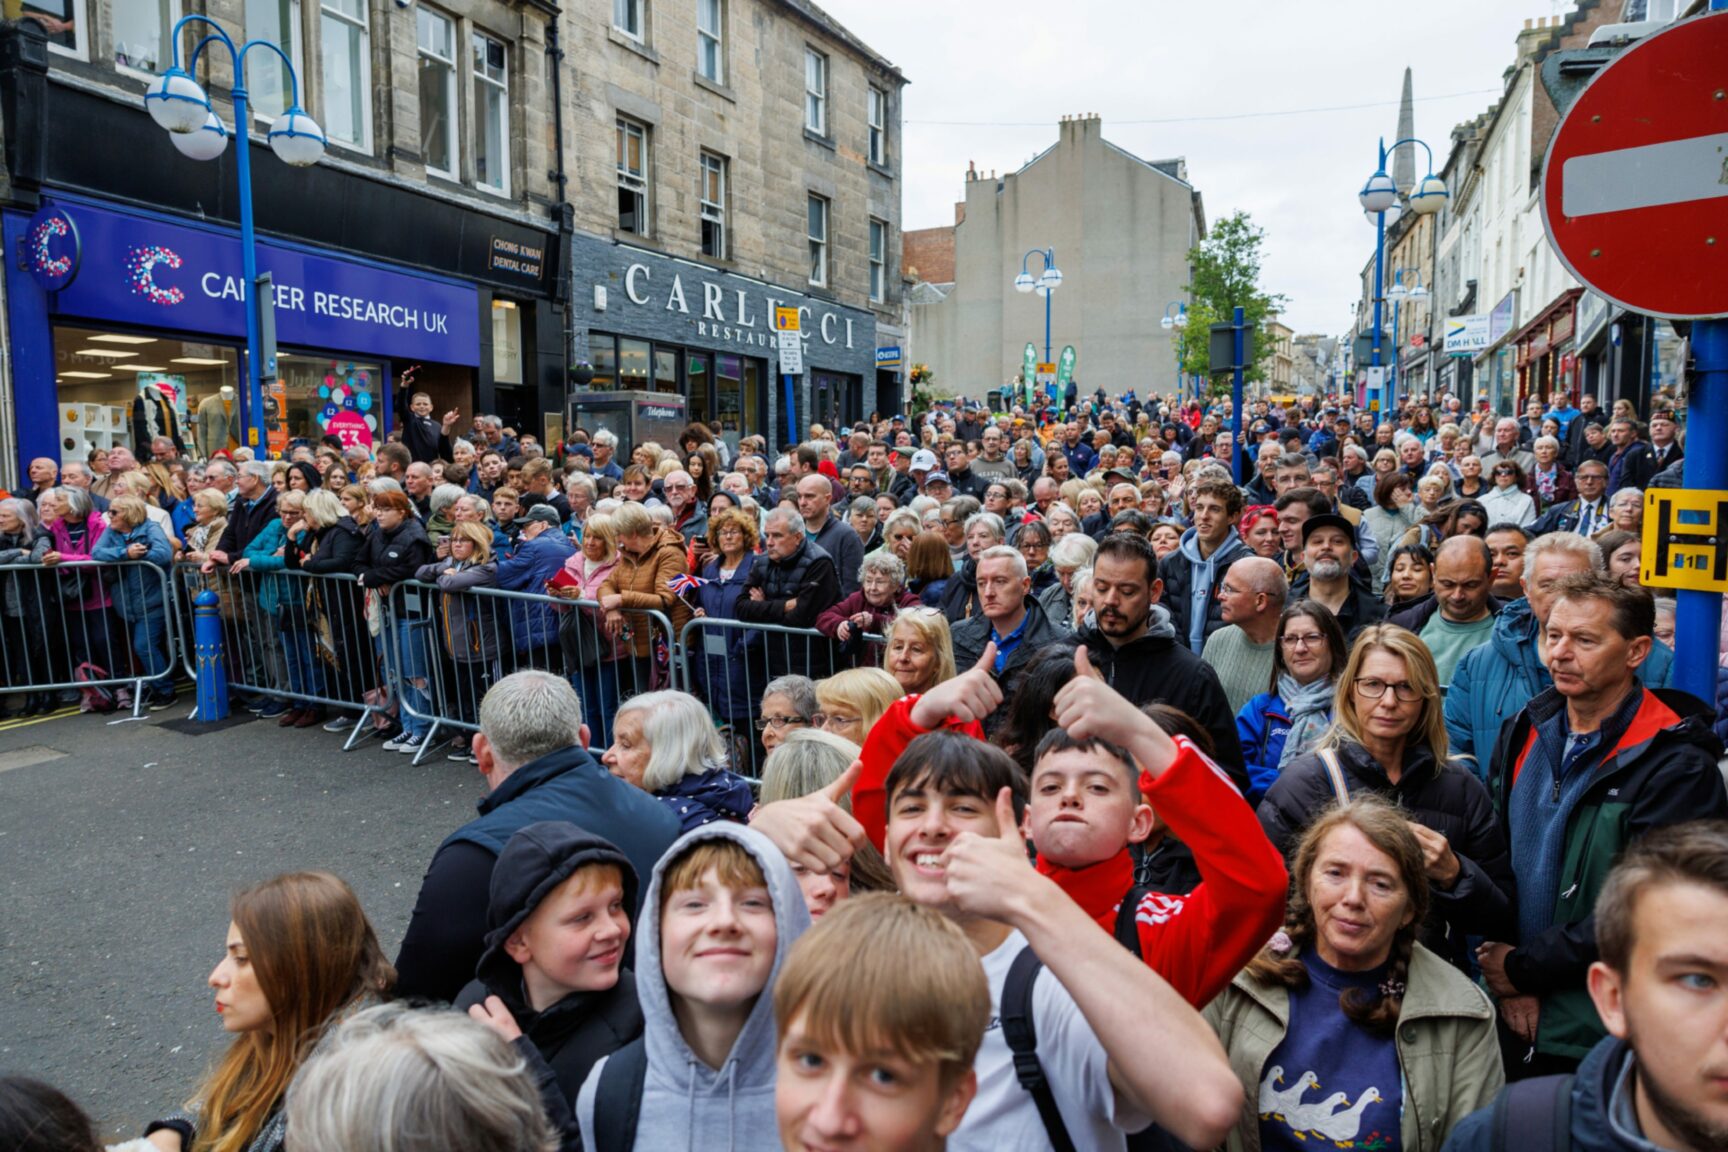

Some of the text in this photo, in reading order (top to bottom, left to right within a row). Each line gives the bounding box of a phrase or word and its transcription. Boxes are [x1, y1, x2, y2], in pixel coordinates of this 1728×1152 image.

[493, 239, 542, 260] CHONG KWAN
[493, 256, 540, 277] DENTAL CARE
[313, 291, 418, 330] RESEARCH
[423, 311, 449, 335] UK
[698, 322, 809, 355] RESTAURT
[326, 407, 336, 416] £2
[646, 406, 676, 418] Telephone
[332, 421, 366, 430] EVERYTHING
[338, 430, 361, 450] £3
[1686, 555, 1694, 569] 1
